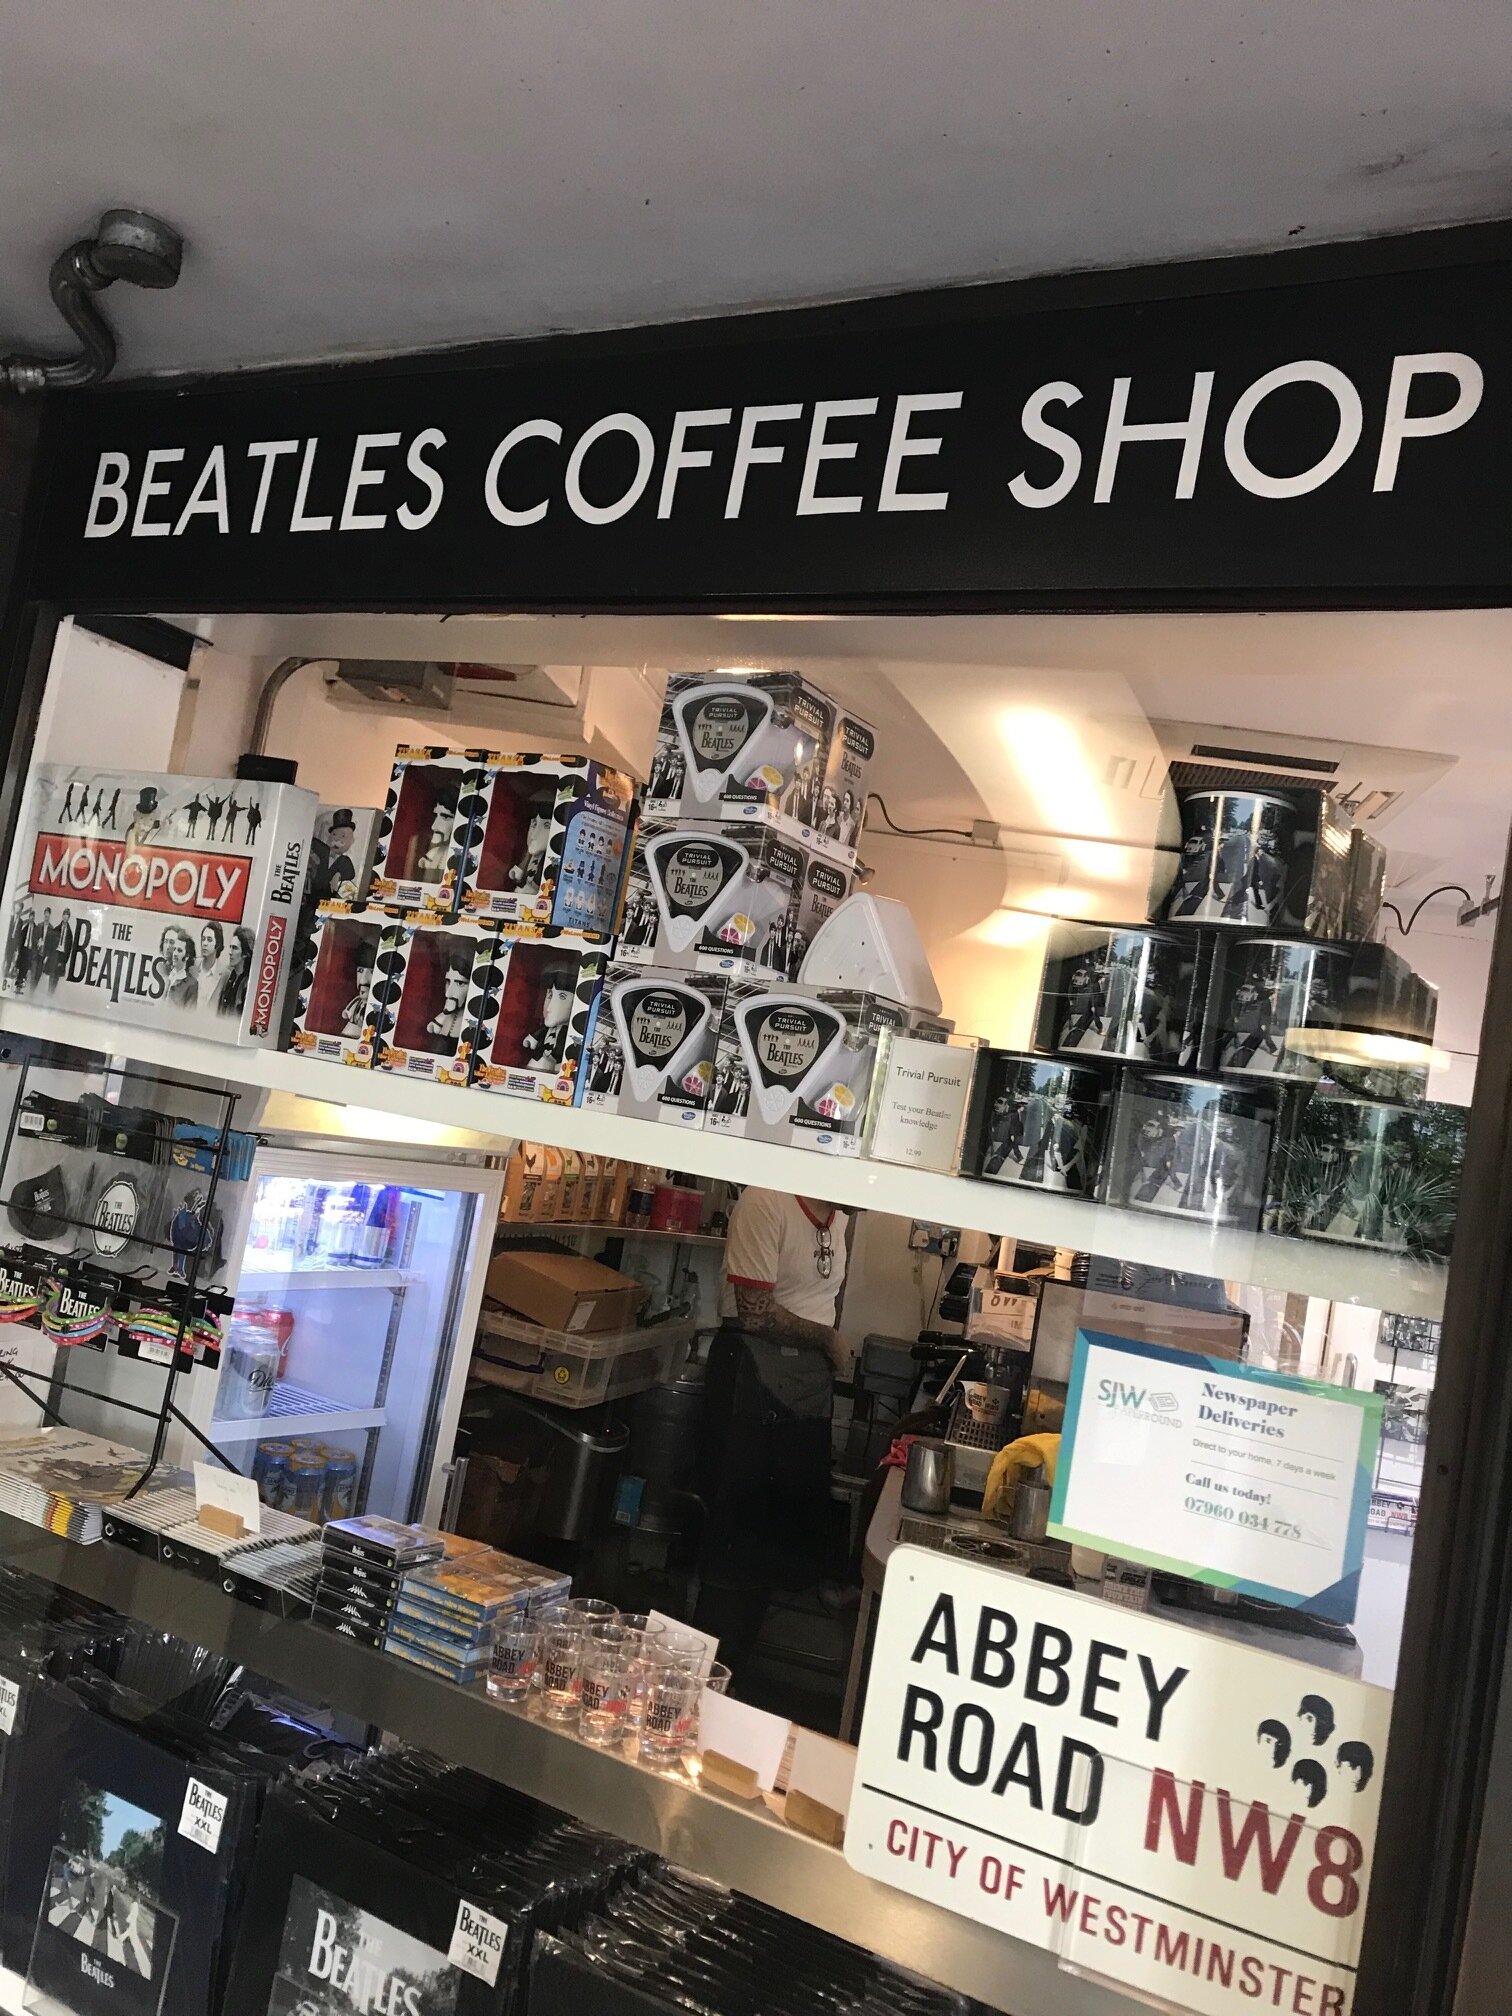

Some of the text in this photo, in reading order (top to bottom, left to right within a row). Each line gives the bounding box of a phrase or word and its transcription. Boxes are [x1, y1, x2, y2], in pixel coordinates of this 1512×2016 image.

[84, 351, 1484, 538] BEATLES COFFEE SHOP
[794, 704, 824, 728] PURSUIT
[798, 696, 824, 720] TRIVIAL
[701, 732, 735, 751] BEATLES
[842, 735, 869, 754] PURSUIT
[845, 726, 869, 747] TRIVIAL
[684, 852, 711, 860] TRIVIAL
[770, 856, 798, 874] PURSUIT
[773, 848, 798, 866] TRIVIAL
[38, 845, 242, 911] MONOPOLY
[271, 842, 301, 905] BEATLES
[274, 864, 282, 878] THE
[816, 870, 840, 886] TRIVIAL
[674, 876, 708, 898] BEATLES
[812, 878, 840, 894] PURSUIT
[112, 922, 133, 942] THE
[708, 946, 734, 954] QUESTIONS
[66, 918, 168, 1003] BEATLES
[255, 920, 282, 1025] MONOPOLY
[647, 1006, 676, 1015] PURSUIT
[650, 1001, 675, 1010] TRIVIAL
[774, 1022, 808, 1032] PURSUIT
[778, 1017, 806, 1026] TRIVIAL
[639, 1026, 672, 1048] BEATLES
[766, 1042, 804, 1066] BEATLES
[896, 1066, 962, 1087] Trivial Pursuit
[670, 1096, 696, 1106] QUESTIONS
[892, 1102, 906, 1111] Test
[908, 1106, 924, 1116] your
[804, 1118, 832, 1128] QUESTIONS
[900, 1116, 938, 1130] knowledge
[98, 1200, 134, 1233] BEATLES
[0, 1267, 35, 1298] BEATLES
[14, 1270, 22, 1280] THE
[60, 1288, 100, 1318] BEATLES
[78, 1290, 88, 1300] THE
[1098, 1378, 1148, 1408] SJW
[1201, 1382, 1298, 1418] Newspaper
[1198, 1404, 1285, 1440] Deliveries
[1192, 1438, 1216, 1452] Direct
[1218, 1445, 1226, 1454] to
[1228, 1449, 1246, 1459] your
[1284, 1462, 1304, 1474] days
[1313, 1470, 1336, 1481] week
[1185, 1472, 1272, 1506] Call us today!
[1184, 1496, 1302, 1540] 07960 034 778
[493, 1644, 526, 1661] ABBEY
[492, 1657, 516, 1674] ROAD
[545, 1660, 576, 1680] ABBEY
[911, 1592, 1190, 1742] ABBEY
[0, 1687, 16, 1707] TLES
[647, 1701, 682, 1720] ABBEY
[646, 1714, 672, 1732] ROAD
[188, 1782, 224, 1822] BEATLES
[897, 1684, 1364, 1918] ROAD NW8
[194, 1816, 212, 1835] XXL
[886, 1819, 1347, 2016] CITY OF WESTMINSTER
[459, 1906, 502, 1952] BEATLES
[308, 1908, 423, 2016] BEATLES
[467, 1944, 488, 1964] XXL
[80, 1952, 114, 1988] BEATLES
